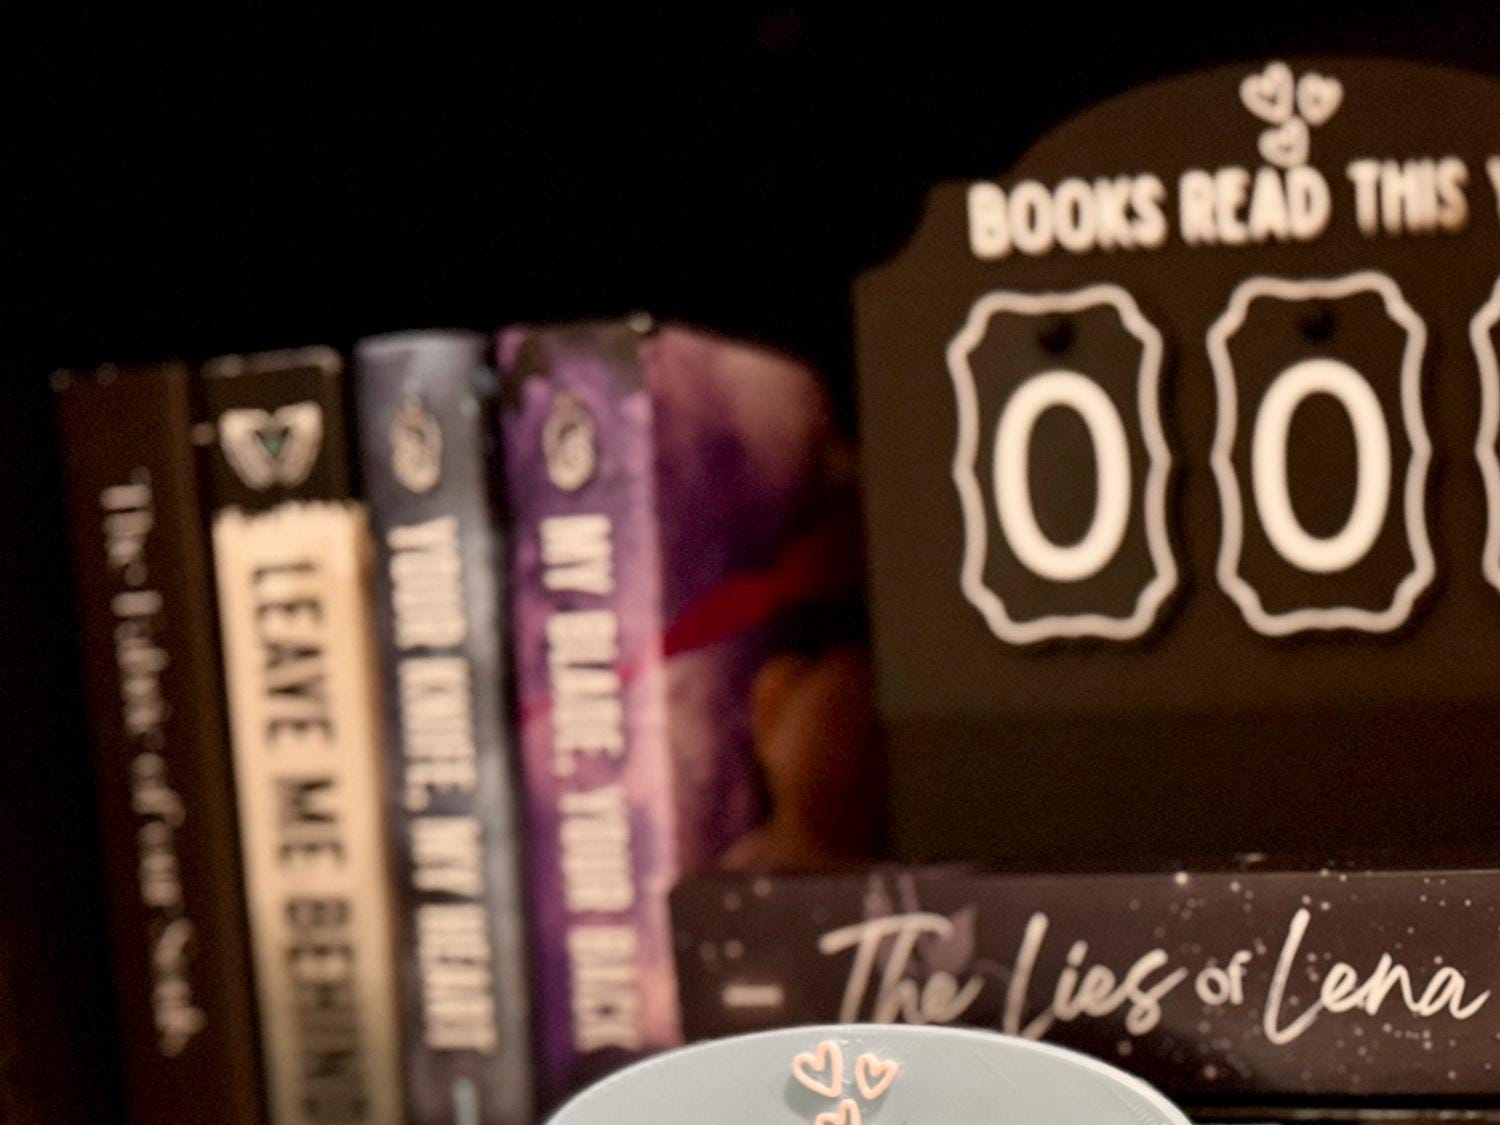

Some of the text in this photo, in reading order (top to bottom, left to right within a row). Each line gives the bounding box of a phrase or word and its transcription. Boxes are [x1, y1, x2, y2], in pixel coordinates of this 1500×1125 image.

[968, 176, 1166, 258] BOOKS
[1179, 168, 1332, 245] READ
[1349, 158, 1469, 238] THIS
[540, 515, 617, 594] MY
[254, 561, 337, 745] LEAVE
[275, 776, 347, 869] ME
[818, 909, 1490, 1044] The Lies of Lena
